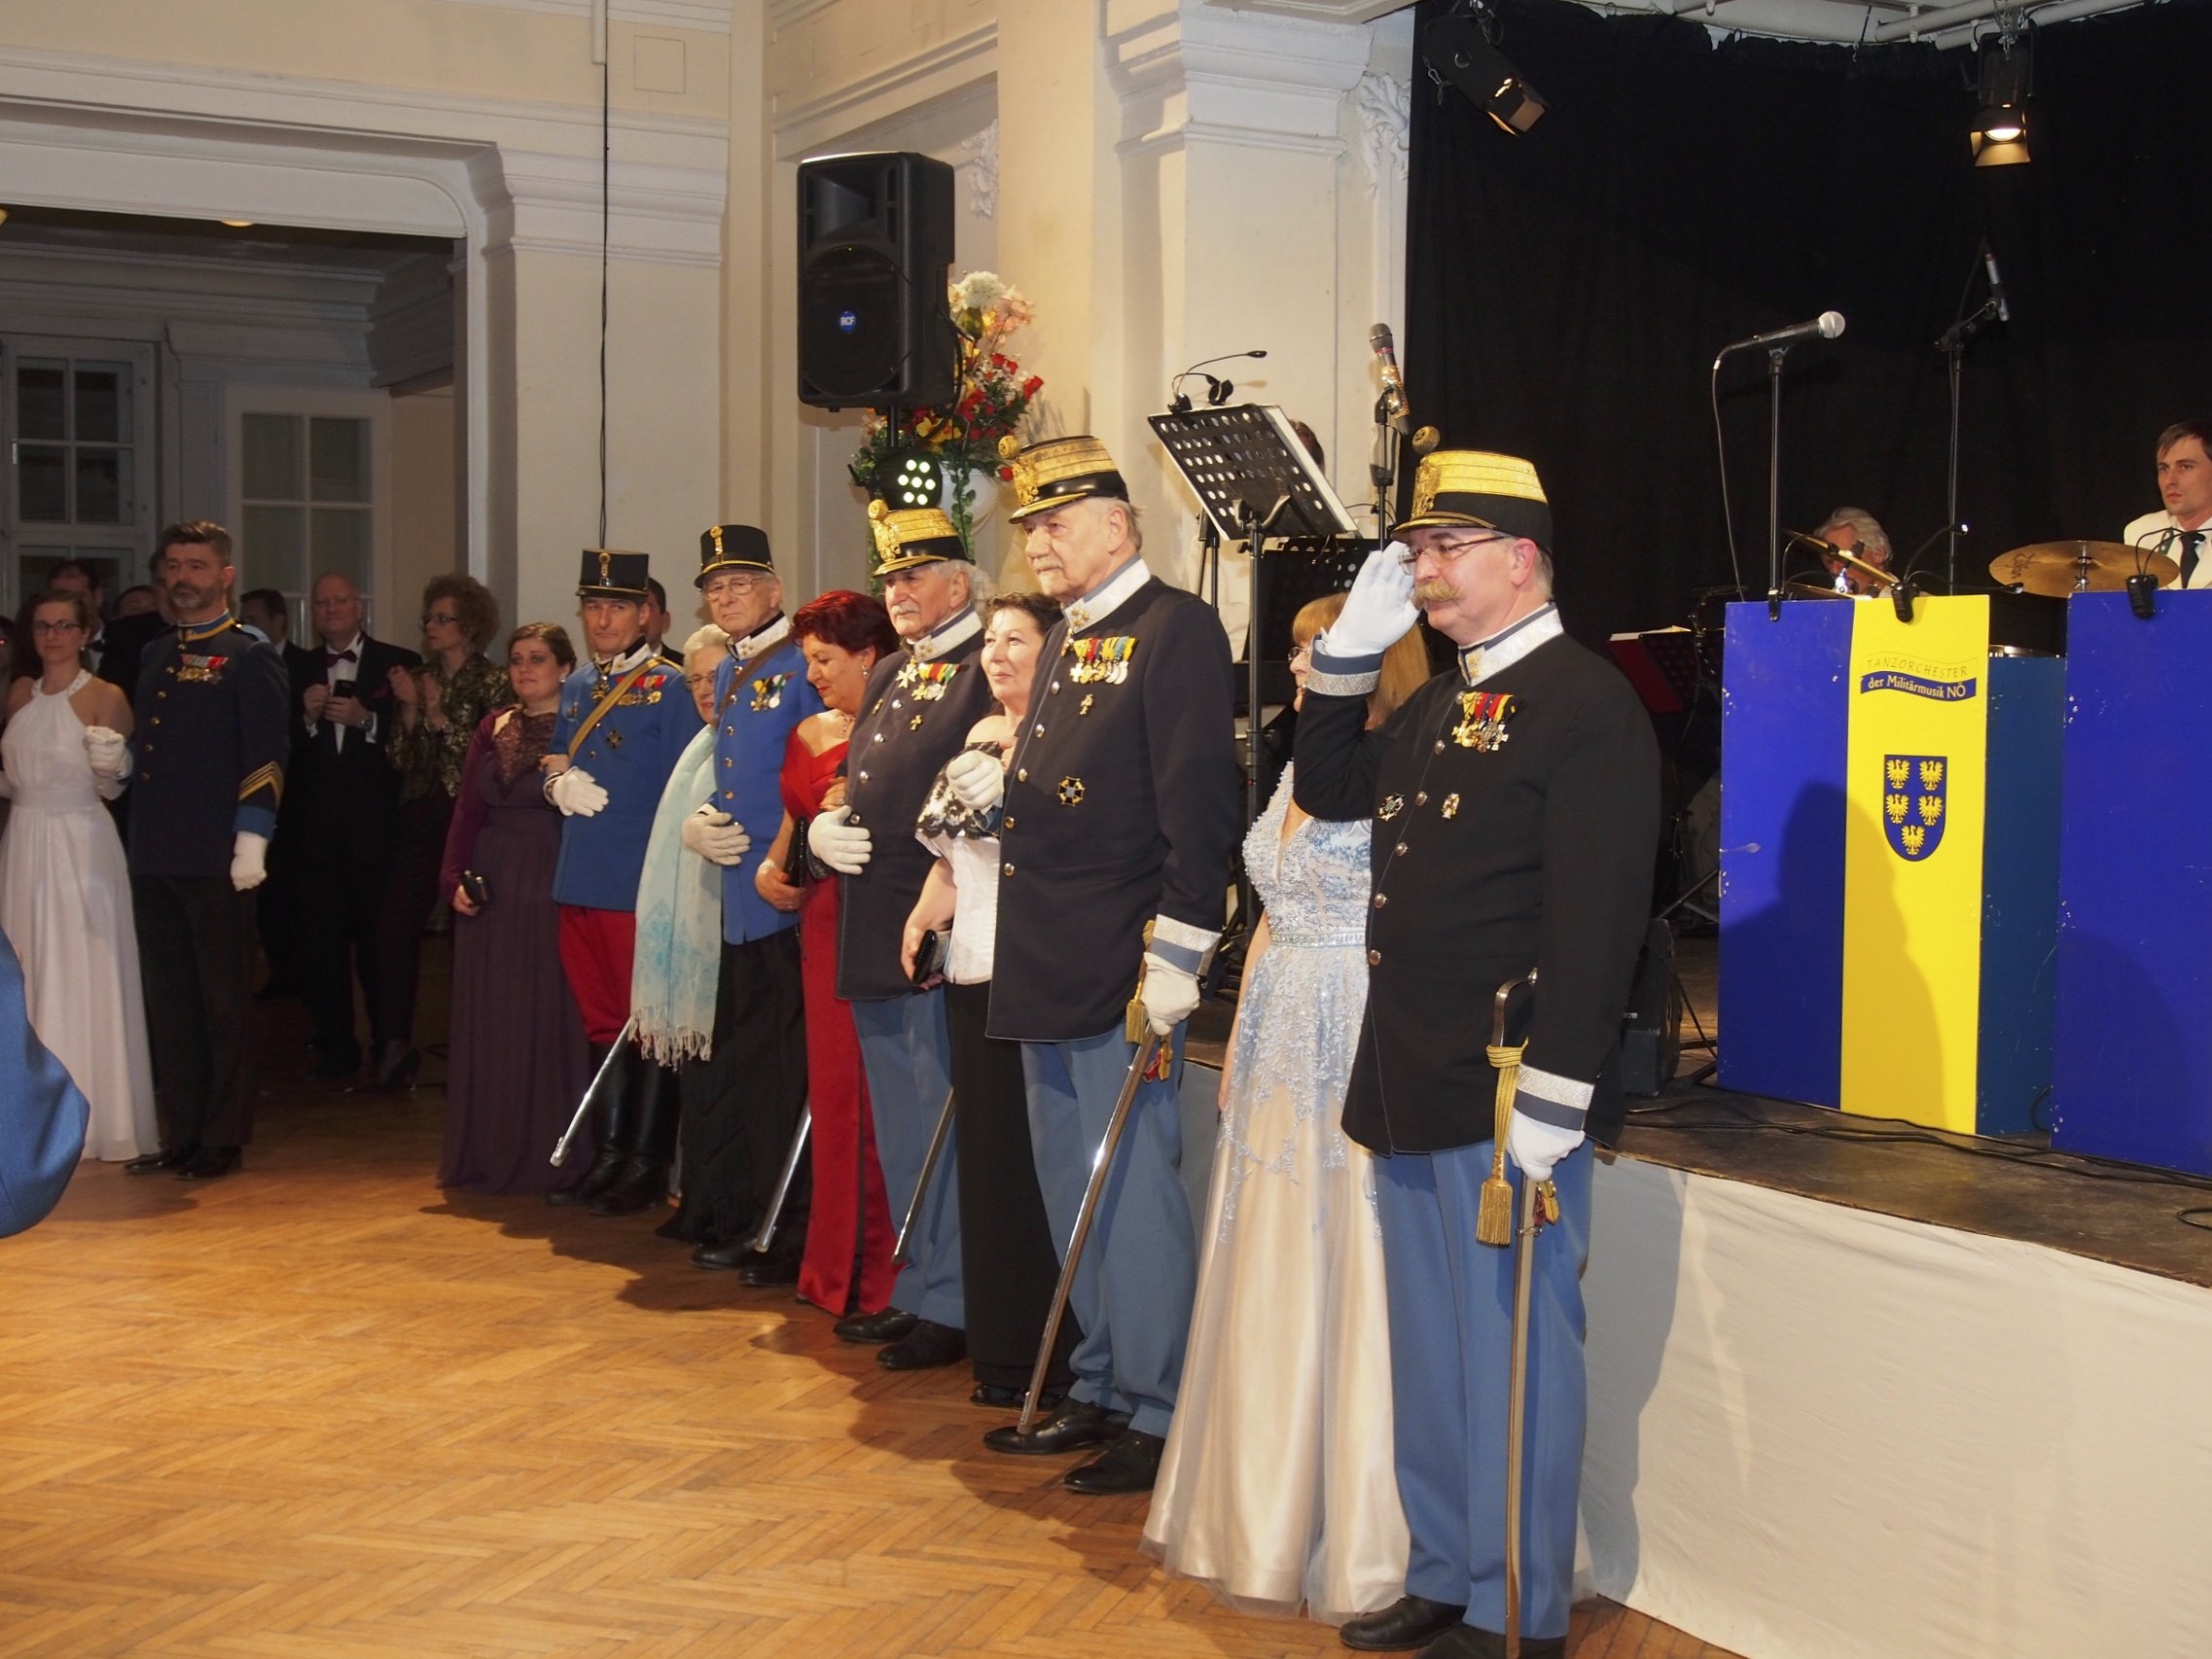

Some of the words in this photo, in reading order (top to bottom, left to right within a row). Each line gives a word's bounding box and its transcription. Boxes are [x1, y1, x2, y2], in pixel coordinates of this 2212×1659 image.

[1868, 656, 1968, 678] TANZORCHESTER
[1868, 677, 1884, 688] der
[1887, 675, 1944, 698] Militärmusik
[1946, 683, 1966, 698] NÖ
